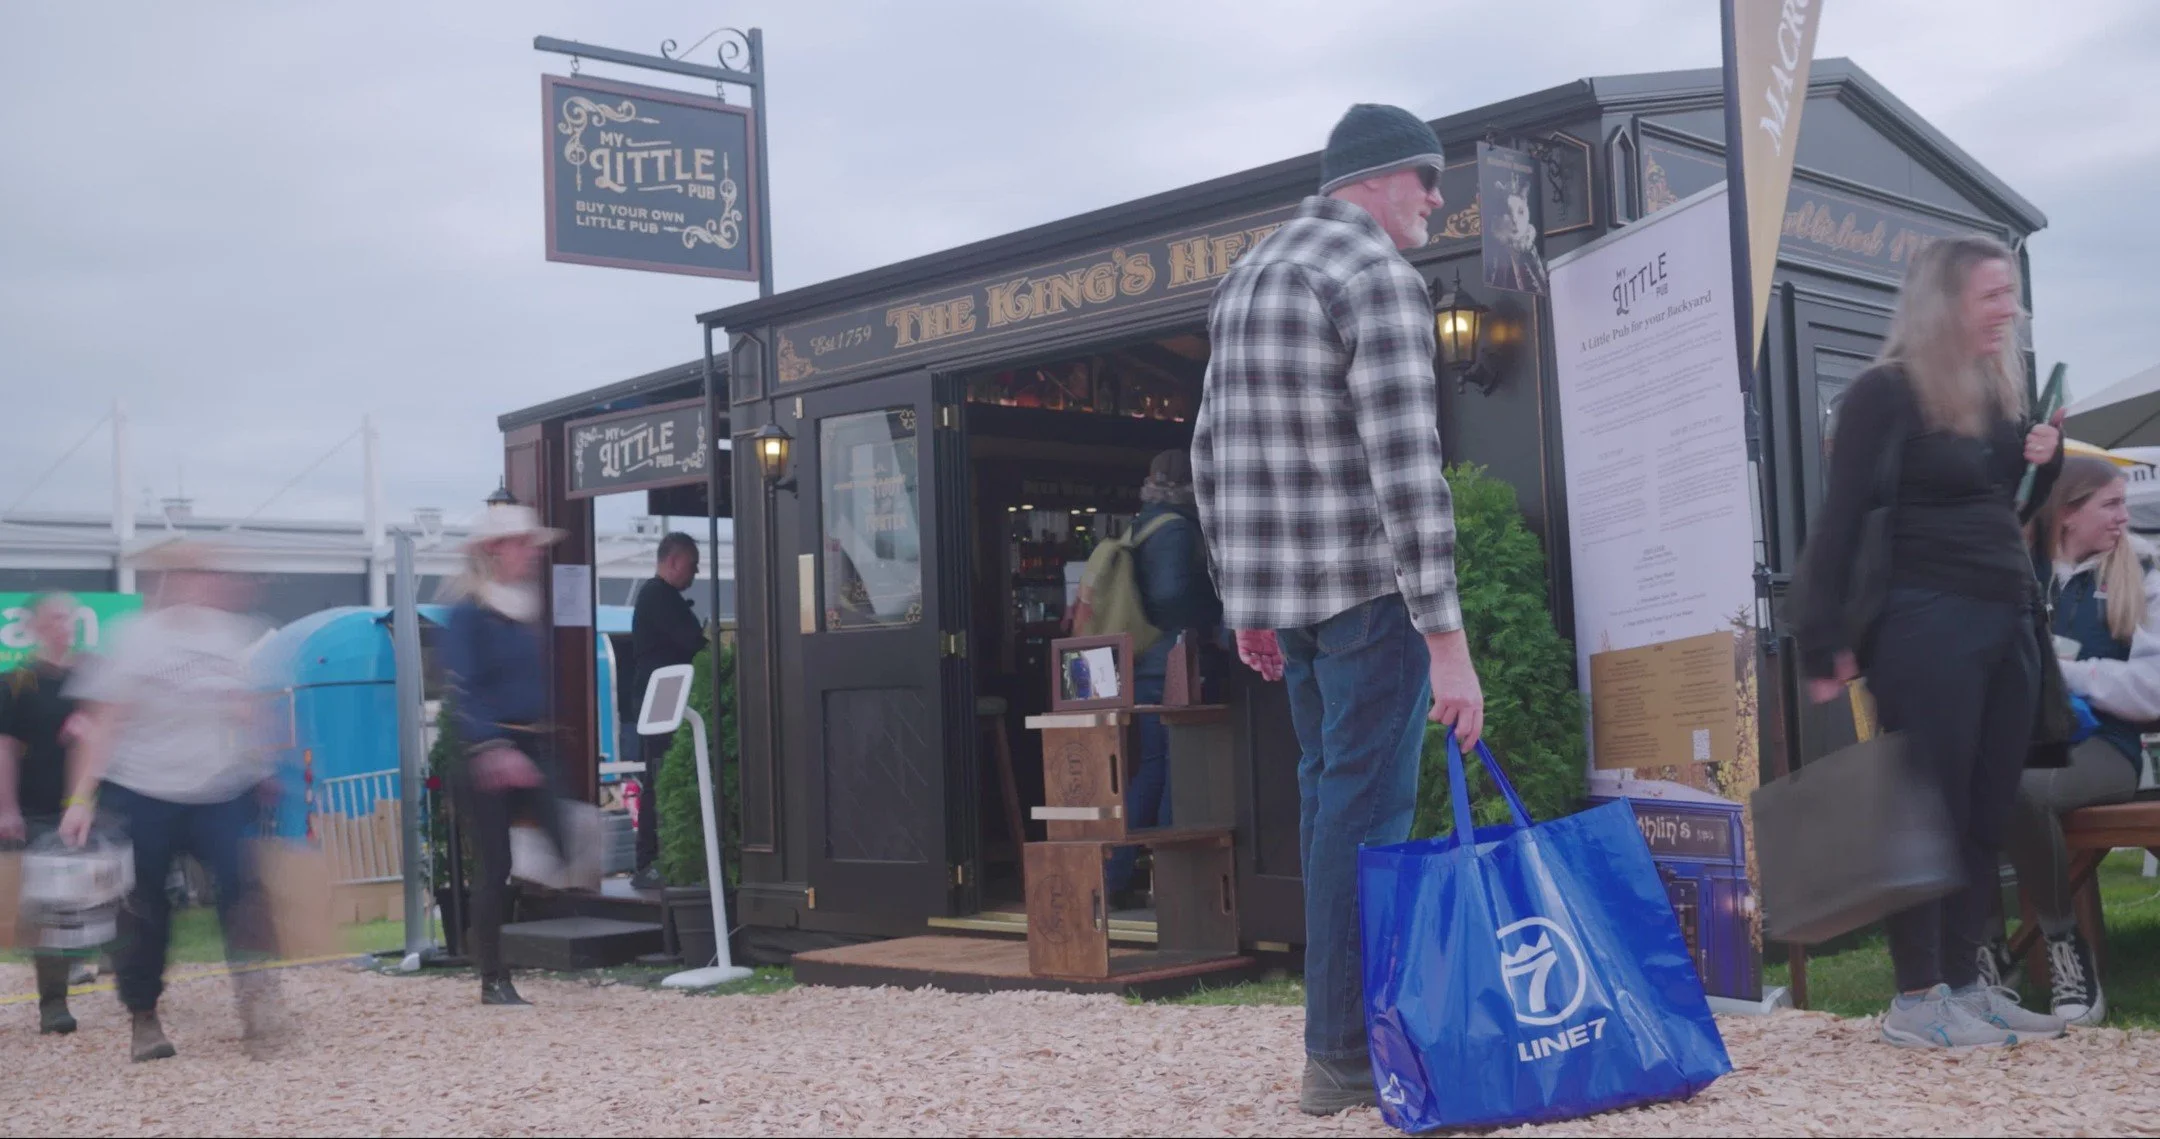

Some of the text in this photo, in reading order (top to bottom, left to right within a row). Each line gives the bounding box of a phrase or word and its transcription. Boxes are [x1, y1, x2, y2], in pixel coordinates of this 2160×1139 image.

[600, 131, 624, 147] MY
[589, 148, 715, 193] LITTLE
[688, 183, 716, 200] PUB
[576, 200, 685, 223] BUY YOUR OWN
[576, 215, 659, 234] LITTLE PUB
[1612, 252, 1667, 316] LITTLE
[1615, 267, 1627, 281] MY
[886, 295, 977, 349] THE
[986, 247, 1155, 328] KING'S
[1588, 331, 1610, 350] Little
[1612, 326, 1630, 340] Pub
[1630, 320, 1643, 333] for
[1644, 312, 1665, 330] your
[1667, 290, 1712, 316] Backyard
[839, 324, 872, 348] 1759
[605, 427, 620, 441] MY
[600, 421, 674, 478] LITTLE
[656, 454, 674, 468] PUB
